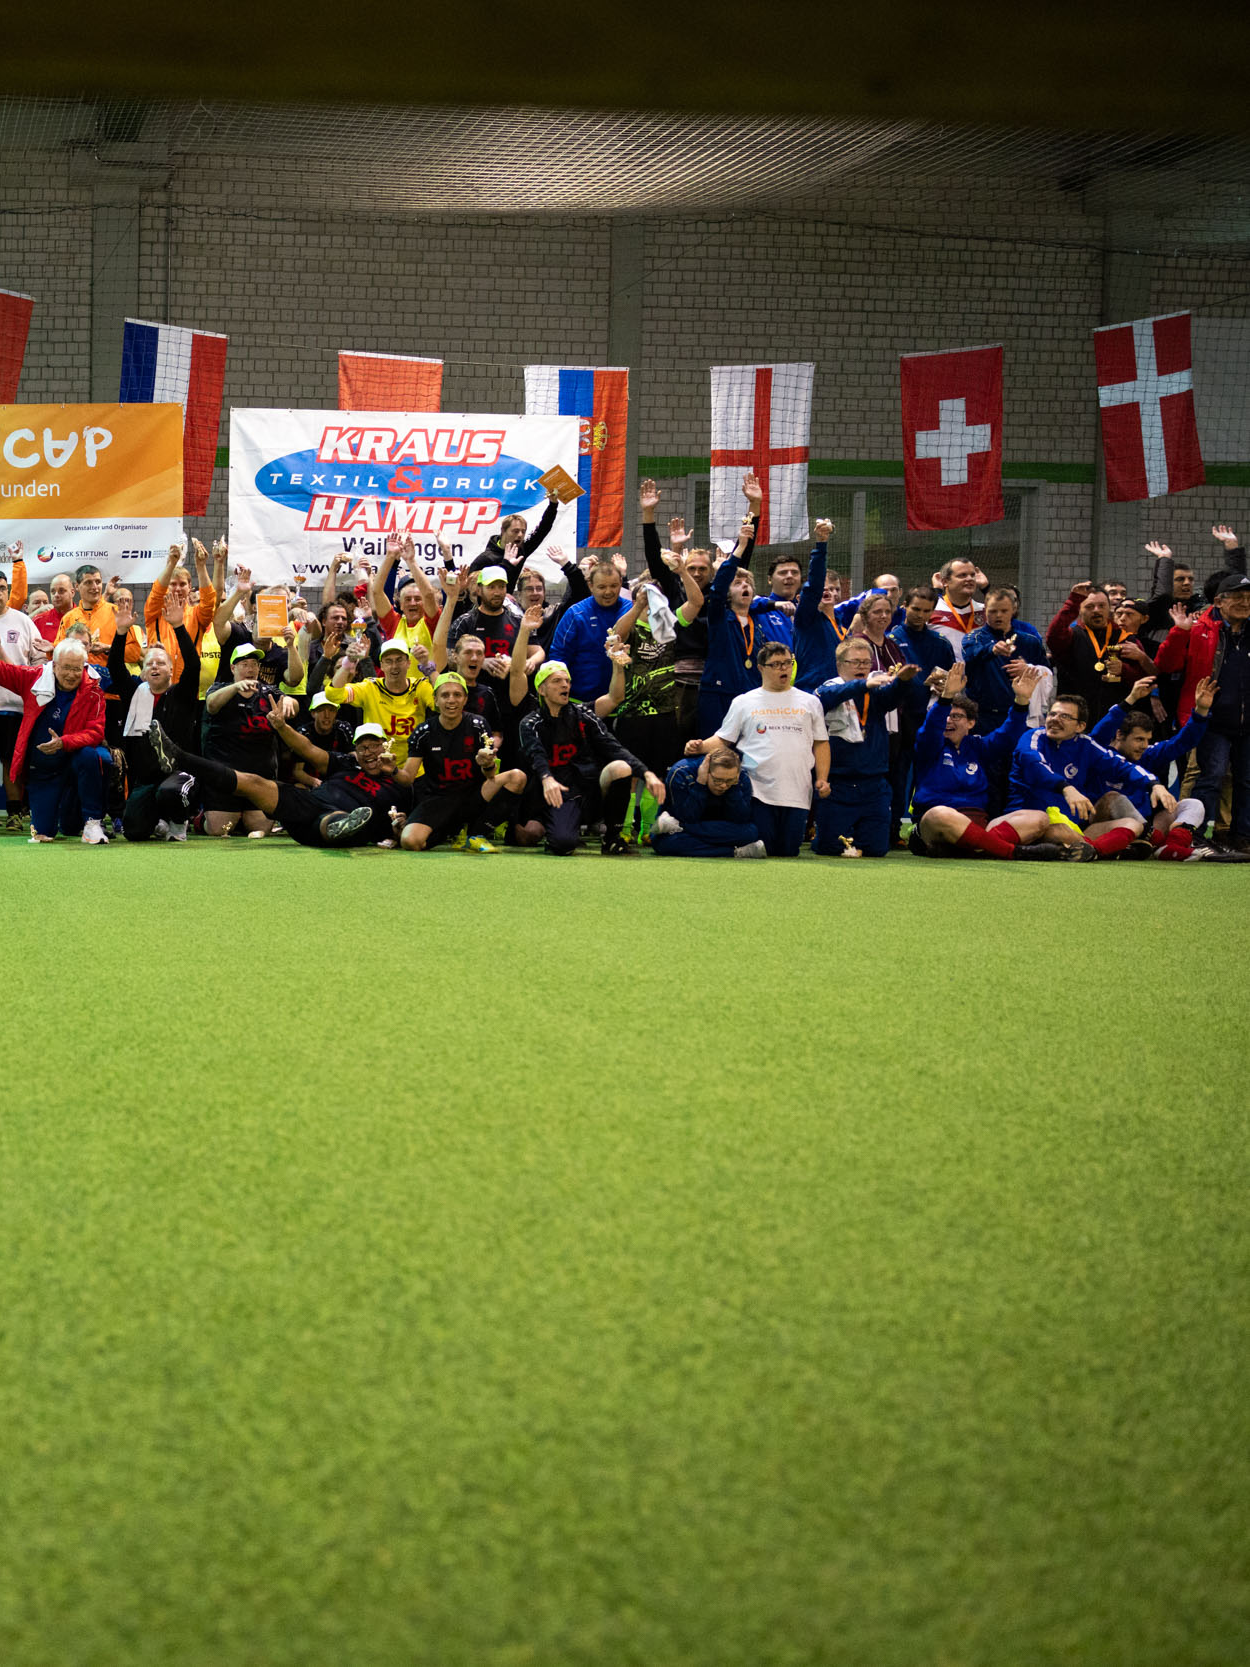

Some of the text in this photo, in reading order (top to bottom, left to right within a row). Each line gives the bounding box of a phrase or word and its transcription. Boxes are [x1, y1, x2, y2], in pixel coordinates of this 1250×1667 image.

[316, 426, 506, 467] KRAUS
[269, 465, 538, 493] TEXTIL & DRUCK
[113, 524, 148, 532] Organisator
[304, 494, 502, 534] HAMPP
[342, 537, 463, 560] Waingn
